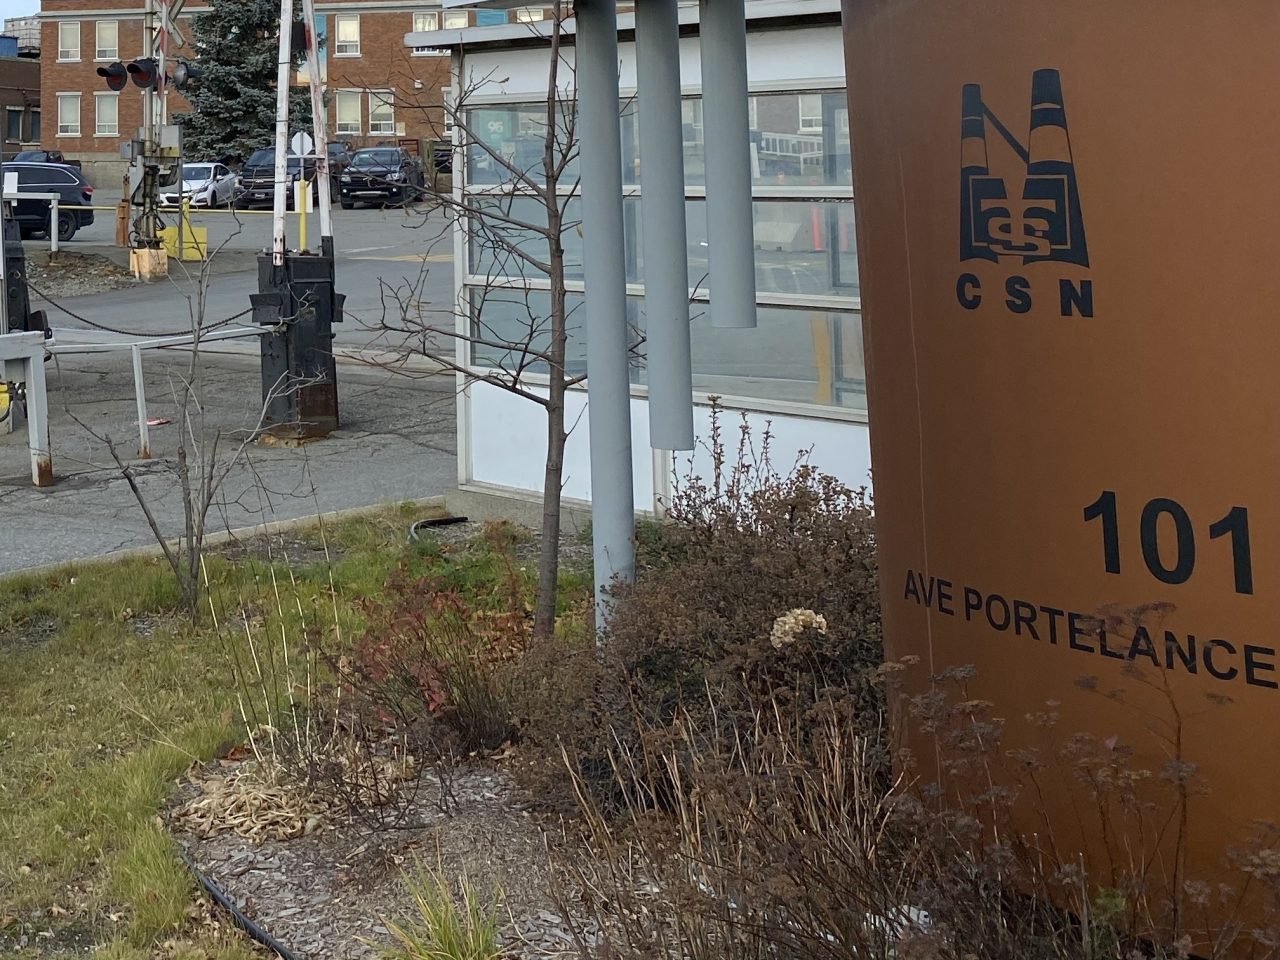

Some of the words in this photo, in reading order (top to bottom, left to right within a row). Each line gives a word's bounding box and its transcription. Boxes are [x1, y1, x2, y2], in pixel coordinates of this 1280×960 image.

[1083, 490, 1254, 596] 101
[904, 569, 956, 616] AVE
[964, 586, 1279, 690] PORTELANCE
